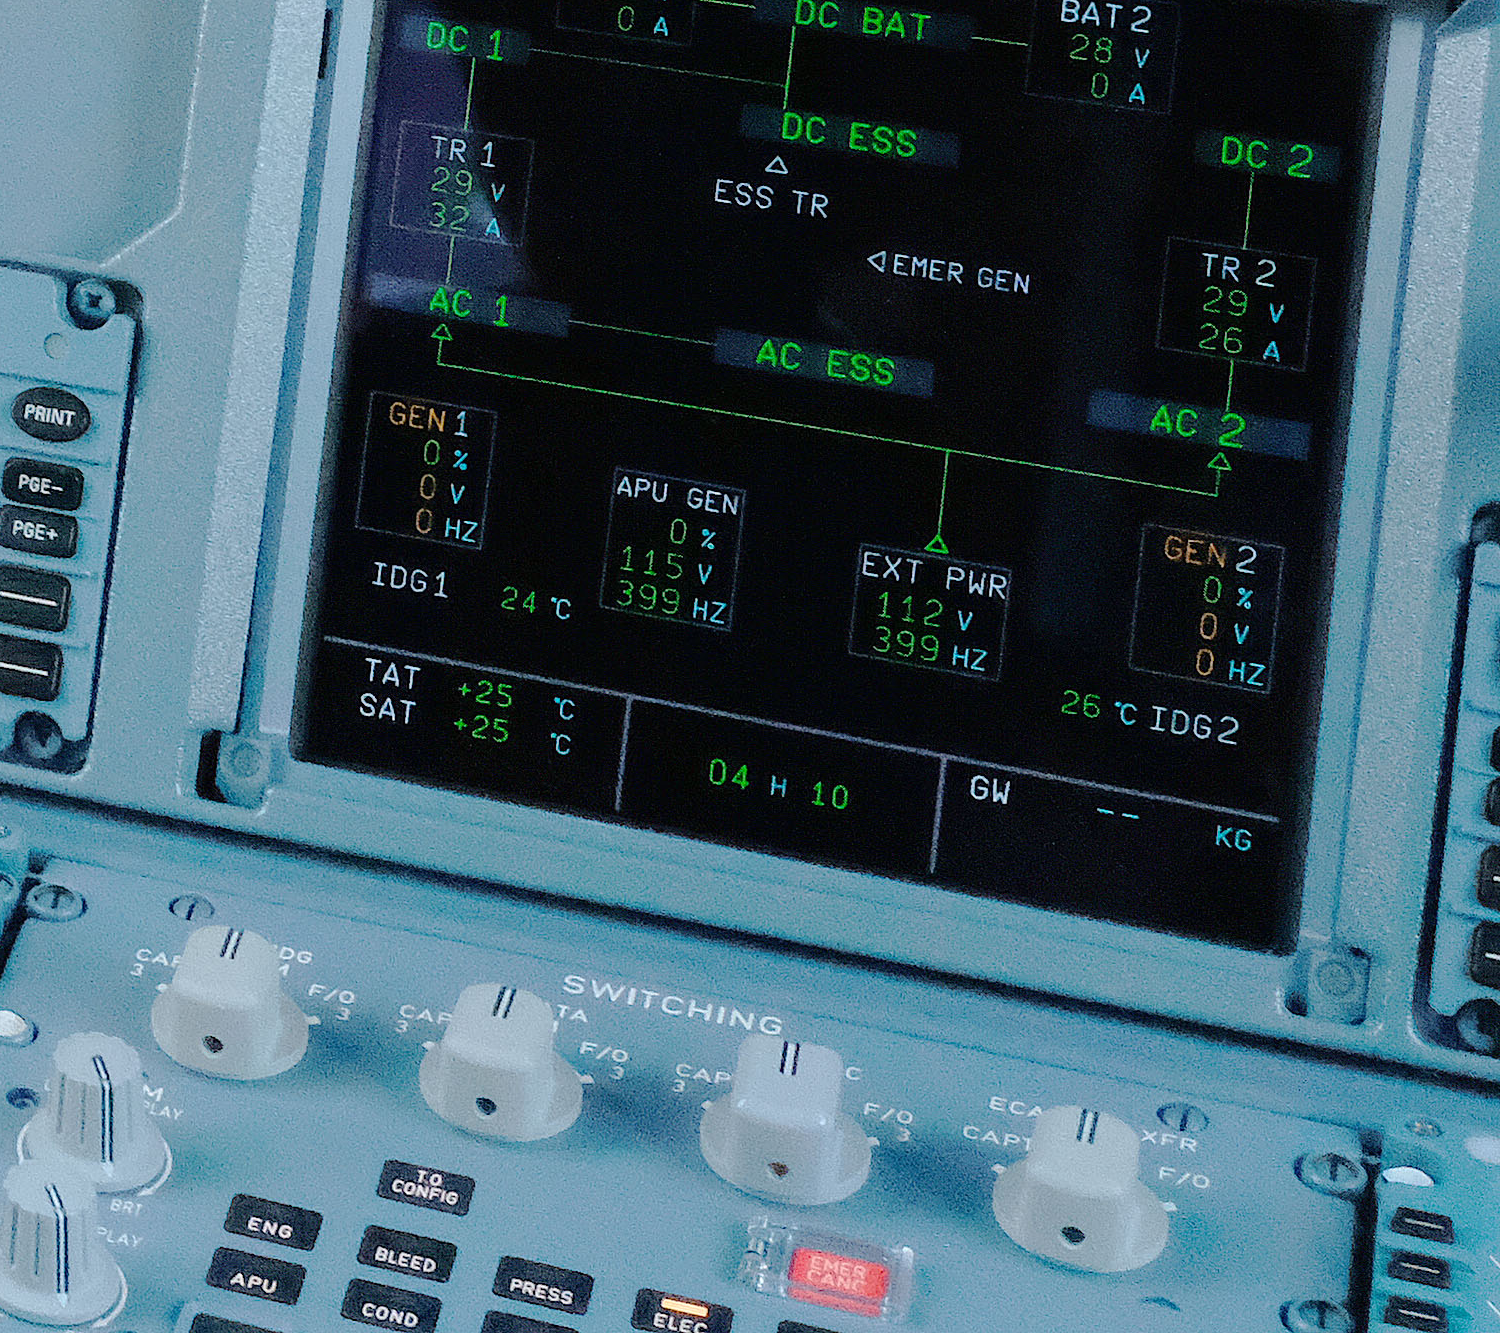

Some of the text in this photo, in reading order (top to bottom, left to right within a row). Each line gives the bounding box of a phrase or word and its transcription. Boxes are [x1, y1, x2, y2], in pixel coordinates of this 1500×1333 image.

[863, 7, 931, 40] BAT
[715, 179, 828, 218] ESS TR
[978, 267, 1030, 293] GEN
[756, 338, 895, 385] AC ESS
[23, 403, 75, 426] PRINT
[617, 476, 738, 516] APU GEN
[862, 550, 1007, 599] EXT PWR
[365, 658, 421, 690] TAT
[459, 680, 512, 707] +25
[308, 985, 355, 1004] F/O
[563, 975, 782, 1034] SWITCHING
[247, 1217, 293, 1239] ENG
[230, 1273, 278, 1293] APU
[510, 1278, 574, 1304] PRESS
